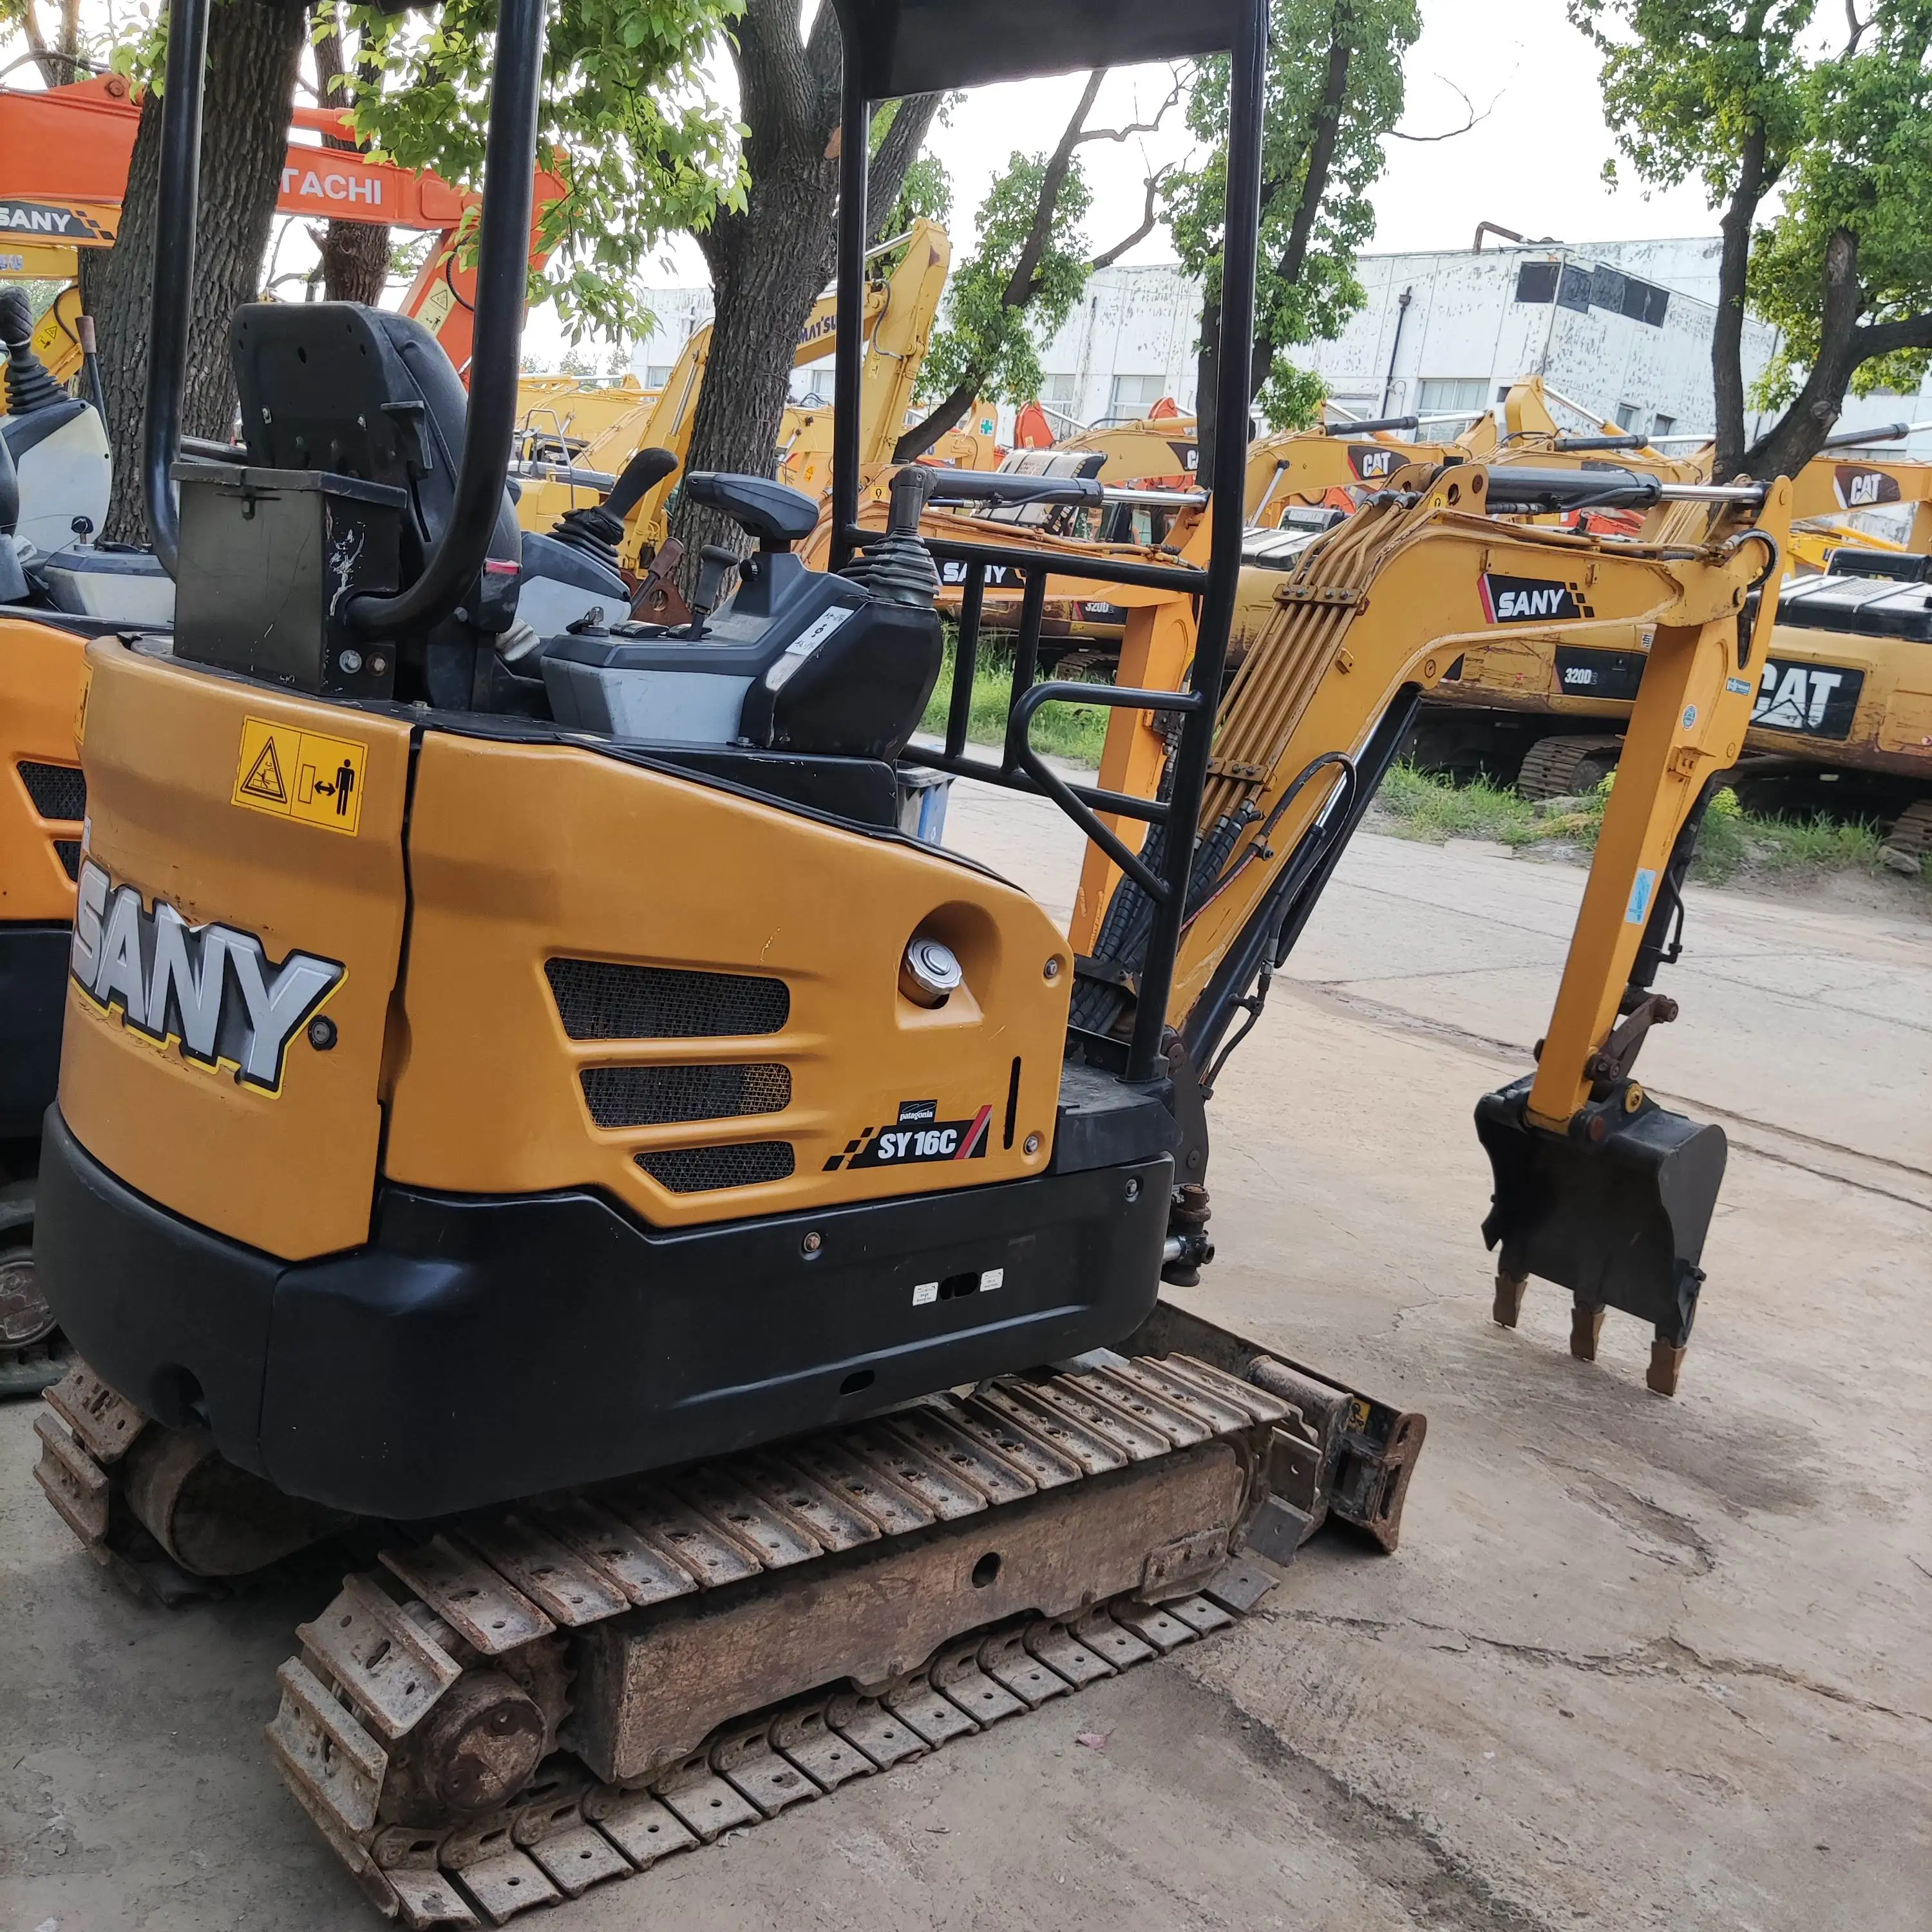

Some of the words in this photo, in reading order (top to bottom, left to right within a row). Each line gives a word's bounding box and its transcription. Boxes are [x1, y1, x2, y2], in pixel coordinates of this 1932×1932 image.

[281, 167, 381, 205] TACHI
[1363, 451, 1391, 477] CAT
[1850, 473, 1882, 505] CAT
[1497, 589, 1565, 617] SANY
[71, 858, 346, 1090] SANY
[900, 1111, 933, 1121] patagonia
